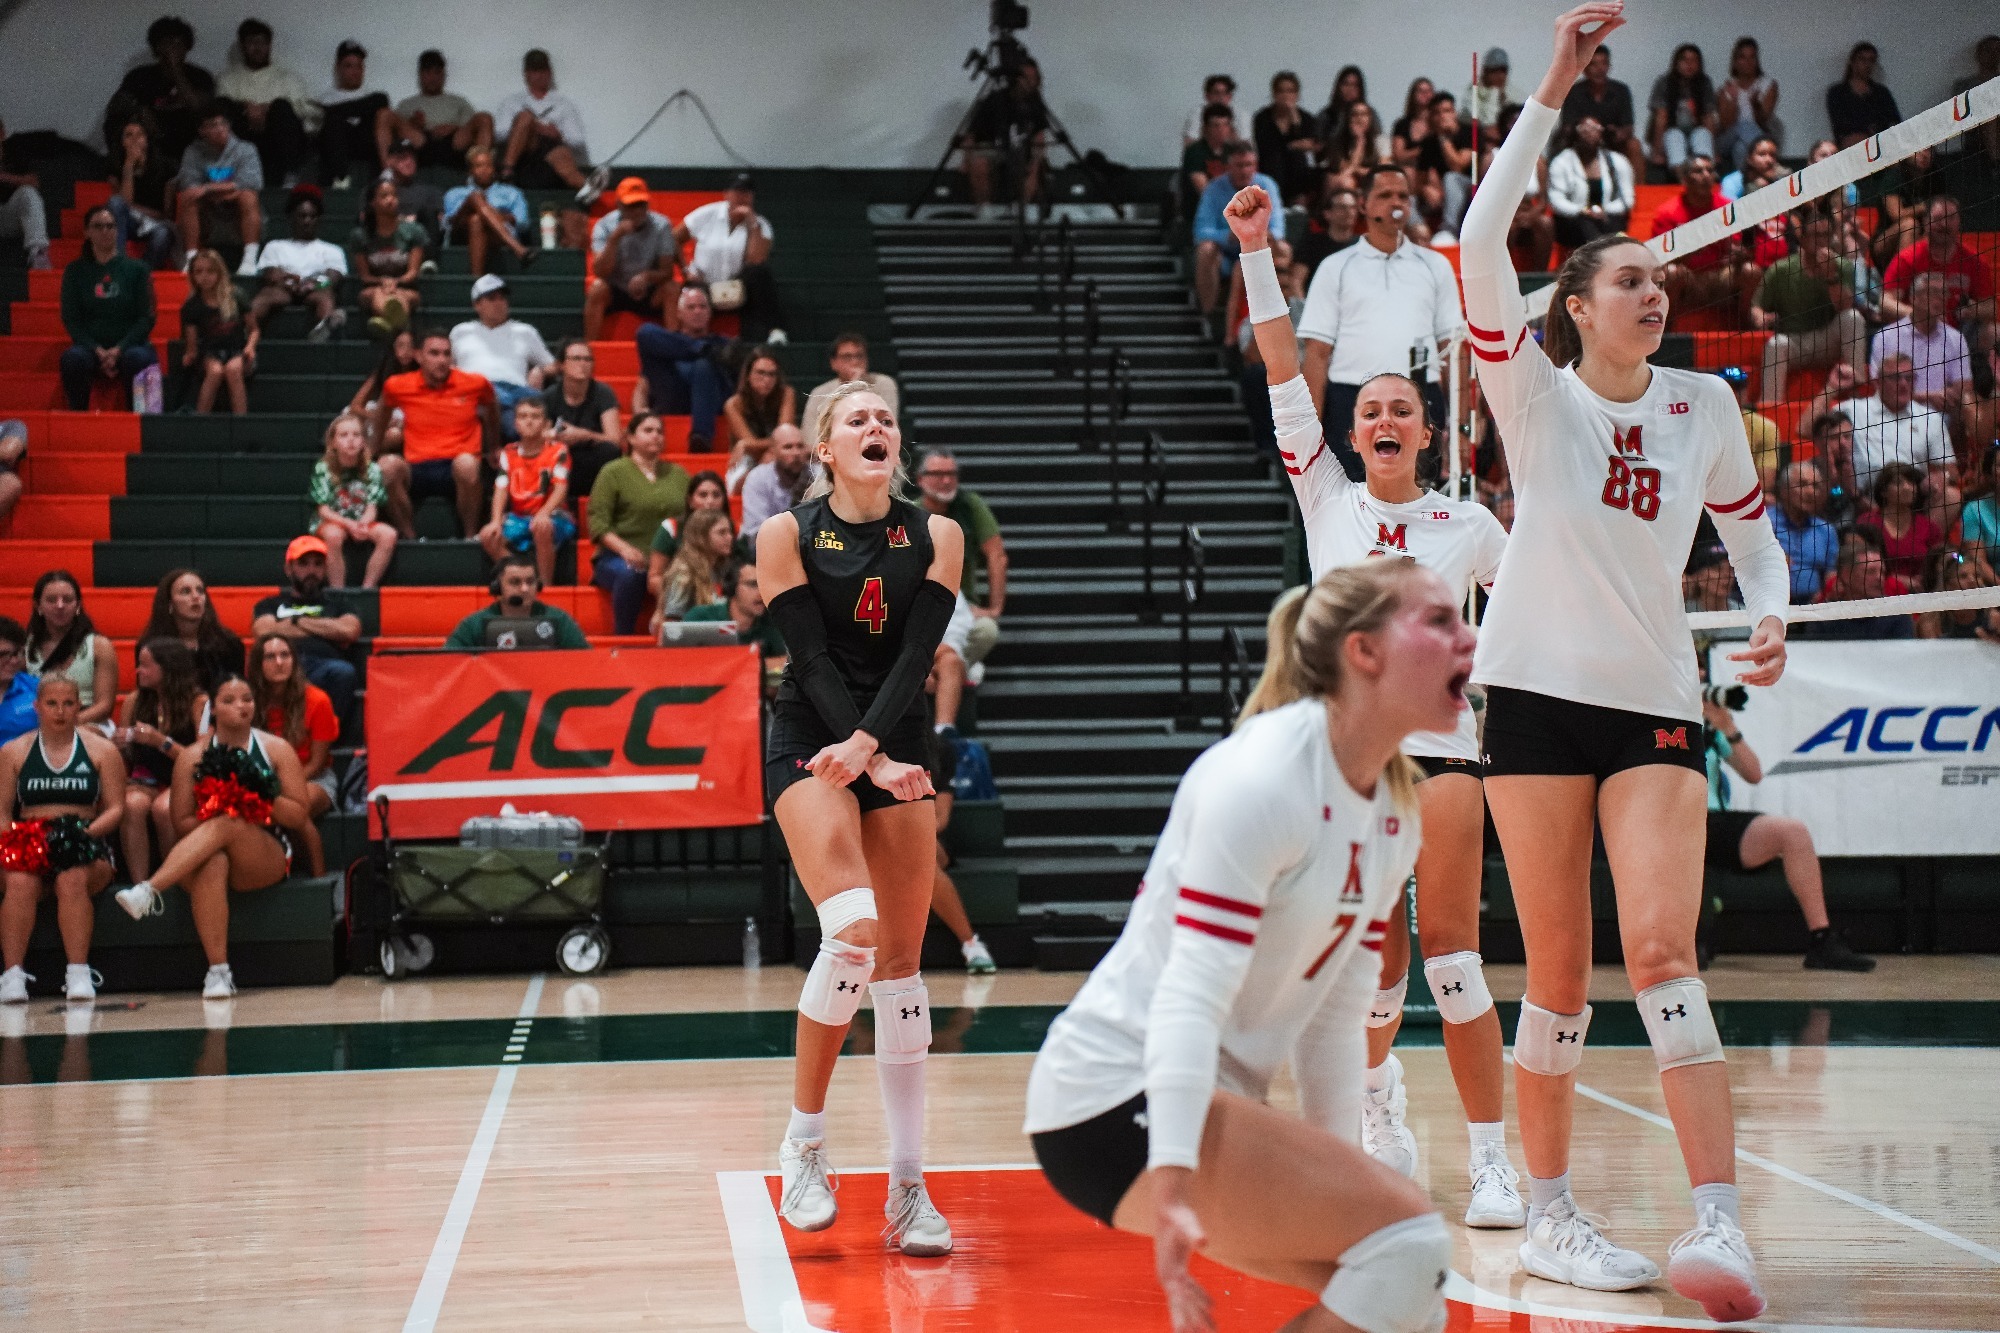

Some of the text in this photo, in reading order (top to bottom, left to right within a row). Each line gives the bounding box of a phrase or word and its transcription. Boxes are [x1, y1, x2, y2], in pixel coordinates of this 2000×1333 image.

[1602, 455, 1661, 521] 88
[886, 525, 912, 549] M
[1377, 523, 1408, 550] M
[854, 576, 888, 634] 4
[396, 684, 728, 776] ACC
[1653, 726, 1690, 750] M
[1304, 914, 1357, 981] 7
